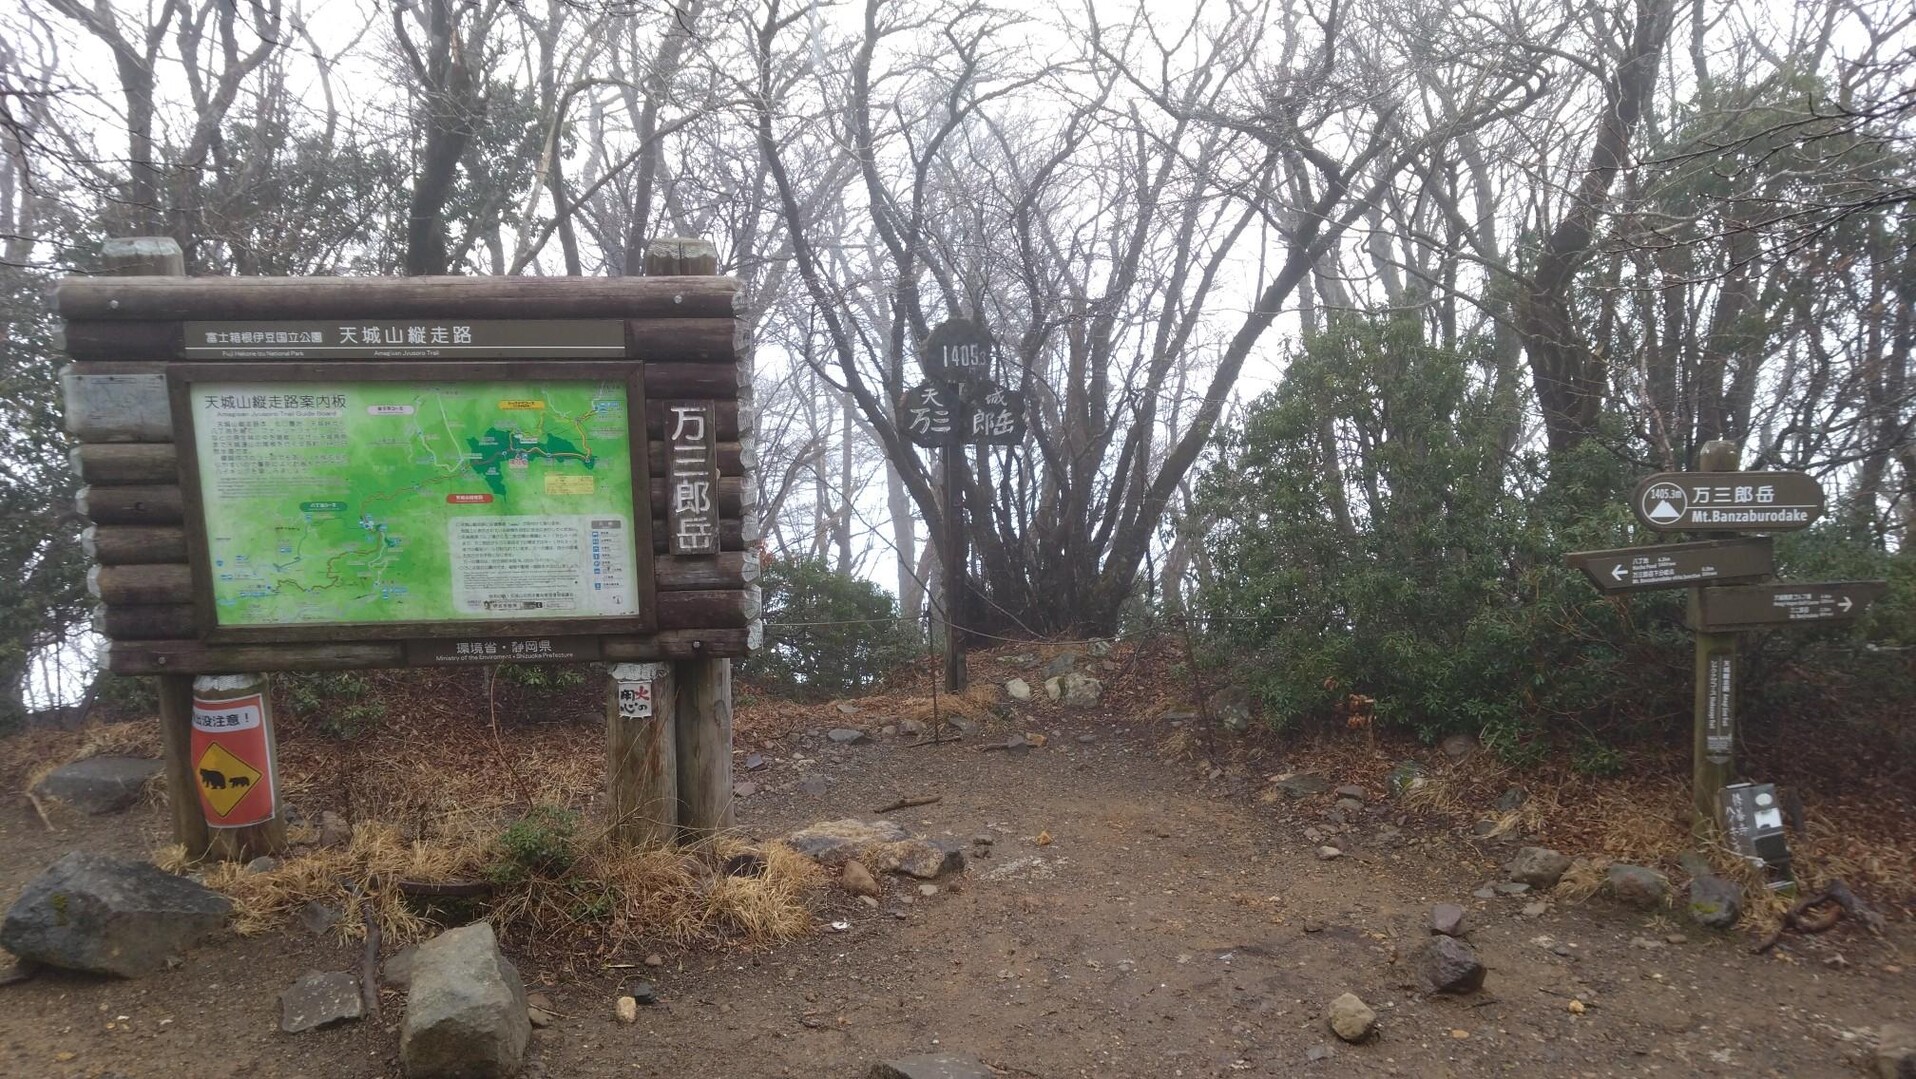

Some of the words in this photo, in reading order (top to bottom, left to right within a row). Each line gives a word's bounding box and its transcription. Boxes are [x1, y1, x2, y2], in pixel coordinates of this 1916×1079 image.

[205, 331, 323, 344] 富士箱根伊豆国立公園
[339, 326, 473, 344] 天城山縦走路
[204, 394, 347, 409] 天城山縦走路案内板
[670, 407, 712, 549] 万三郎岳
[1651, 488, 1682, 499] 1405.3m
[1692, 485, 1776, 503] 万三郎岳
